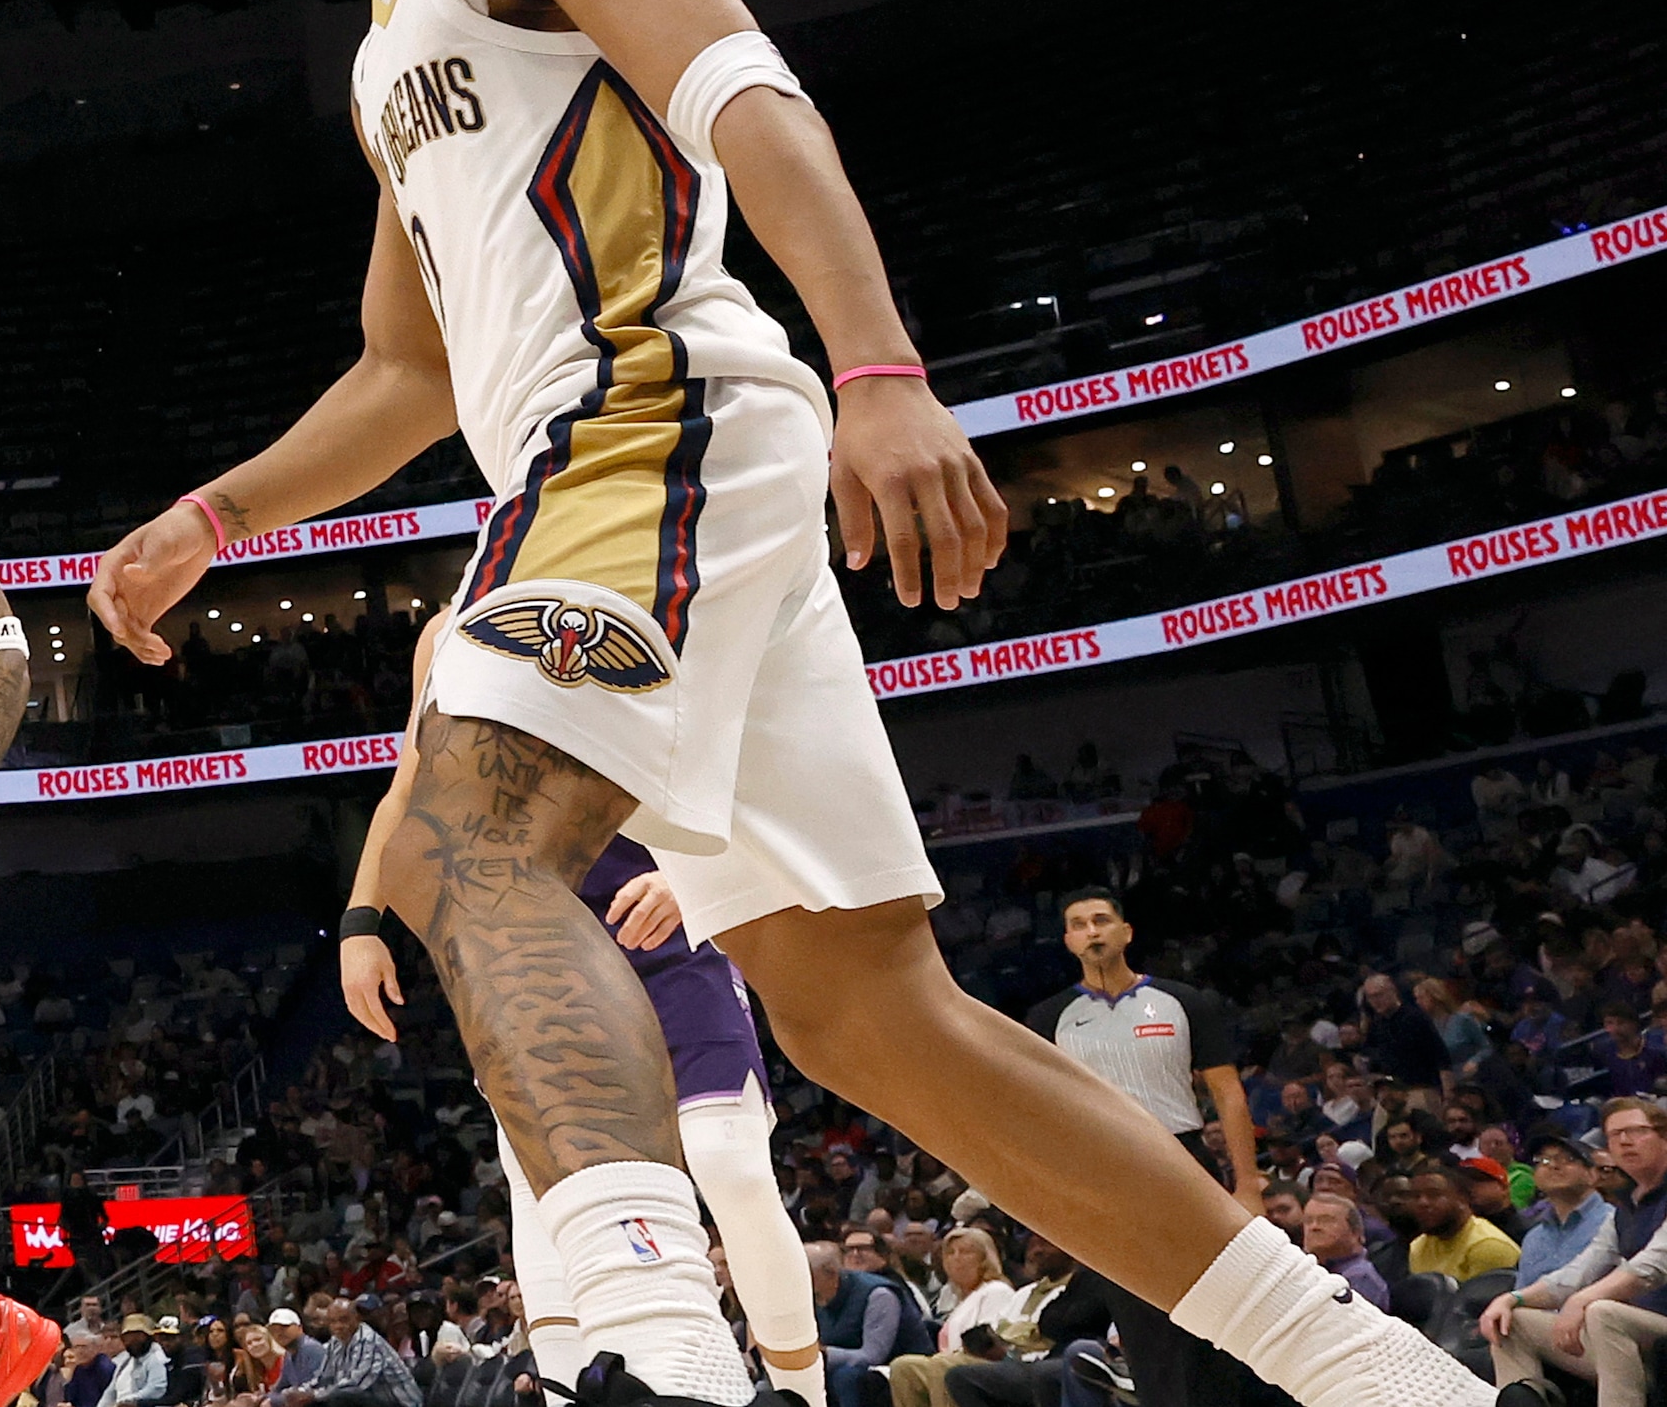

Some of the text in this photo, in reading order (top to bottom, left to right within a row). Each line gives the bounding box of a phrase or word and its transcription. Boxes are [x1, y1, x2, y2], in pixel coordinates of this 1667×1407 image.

[1591, 213, 1667, 260] ROUS
[1302, 257, 1530, 349] ROUSES MARKETS
[1016, 345, 1248, 421] ROUSES MARKETS
[310, 512, 420, 546] MARKETS
[1448, 499, 1667, 576] ROUSES MARKE
[1162, 565, 1387, 643] ROUSES MARKETS
[971, 631, 1100, 676] MARKETS
[39, 754, 246, 796] ROUSES MARKETS
[303, 737, 398, 770] ROUSES
